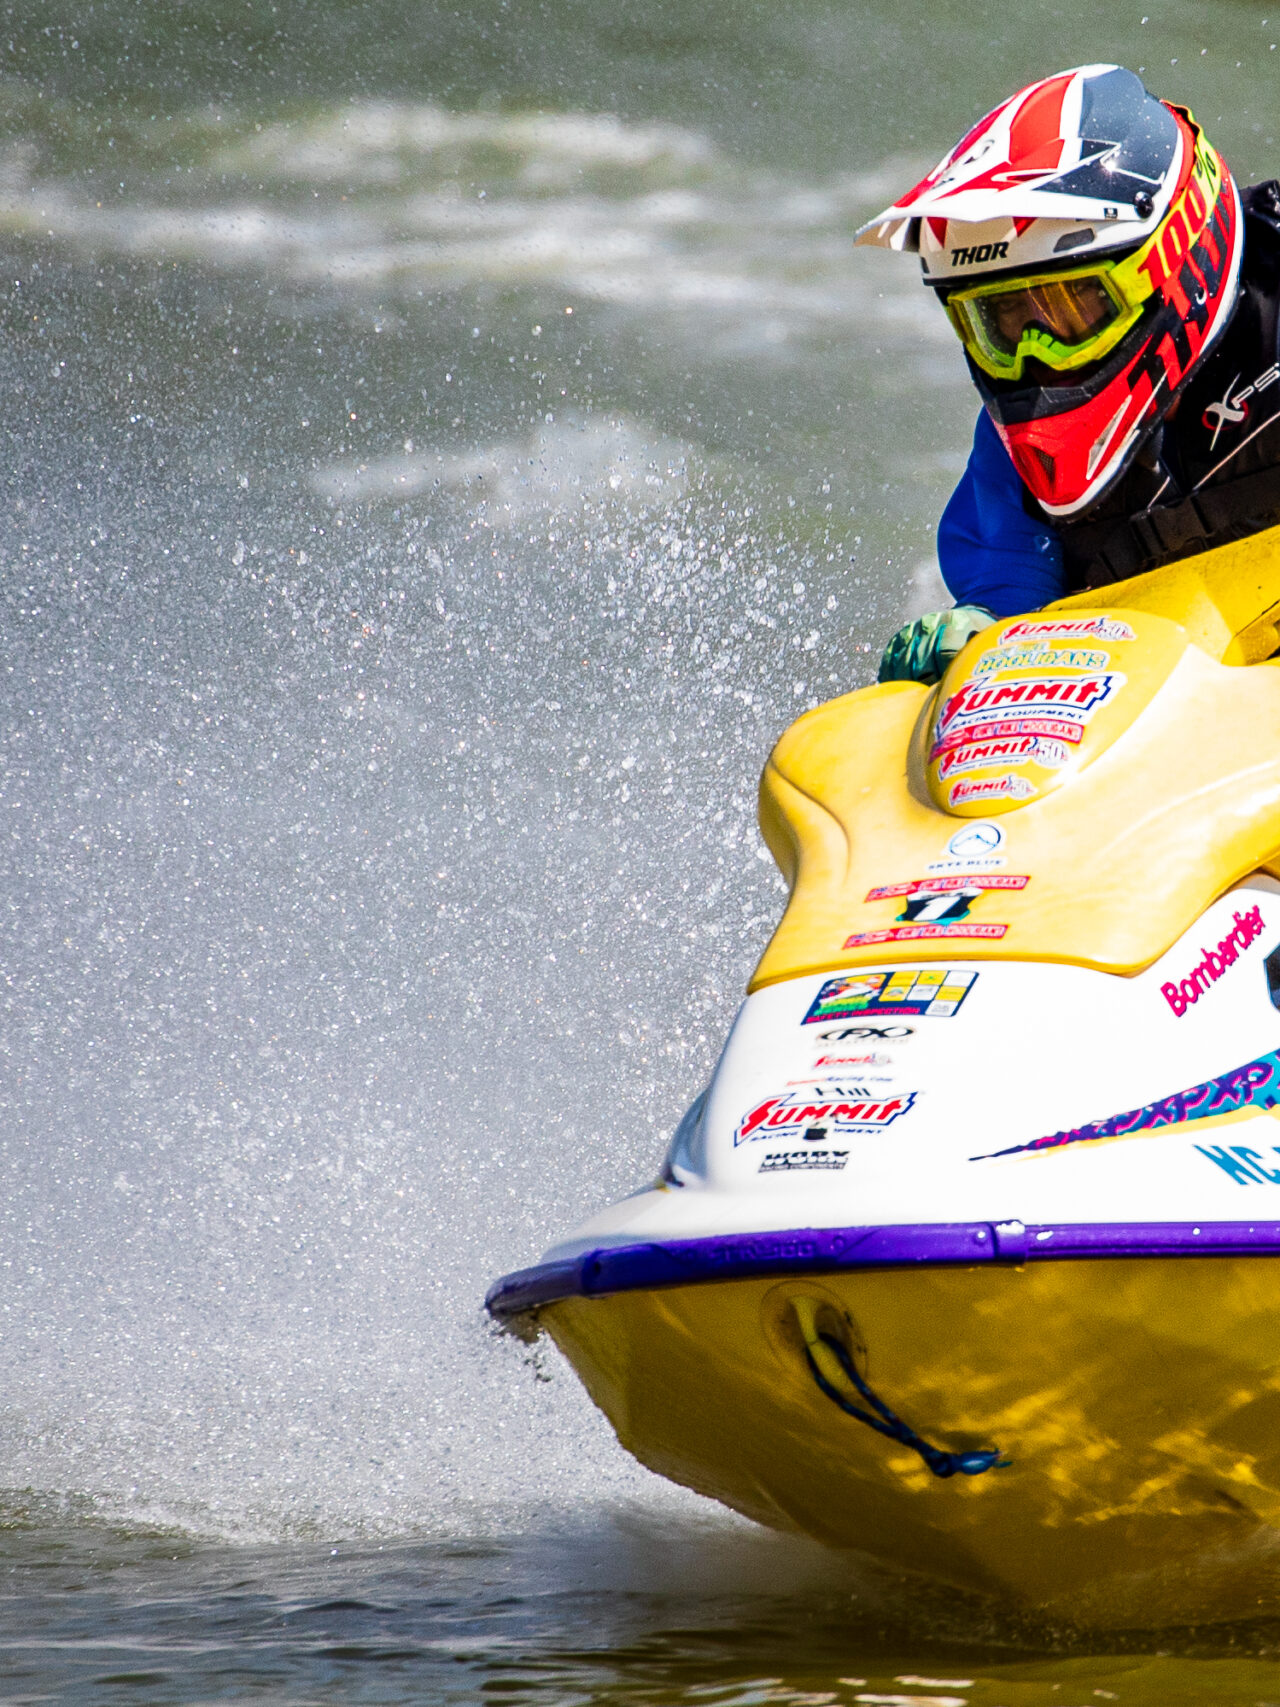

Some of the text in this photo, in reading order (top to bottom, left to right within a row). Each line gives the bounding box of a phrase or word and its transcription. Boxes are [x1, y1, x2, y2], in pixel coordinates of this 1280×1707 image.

[1138, 141, 1217, 290] 100%
[951, 241, 1009, 267] THOR
[1205, 363, 1280, 451] XPS
[1004, 620, 1096, 639] SUMMIT
[942, 681, 1100, 727] SUMMIT
[1003, 709, 1083, 720] EQUIPMENT
[942, 736, 1031, 773] SUMMIT
[952, 780, 1007, 800] SUMMIT
[1160, 904, 1266, 1017] Bombardier
[741, 1099, 902, 1137] SUMMIT
